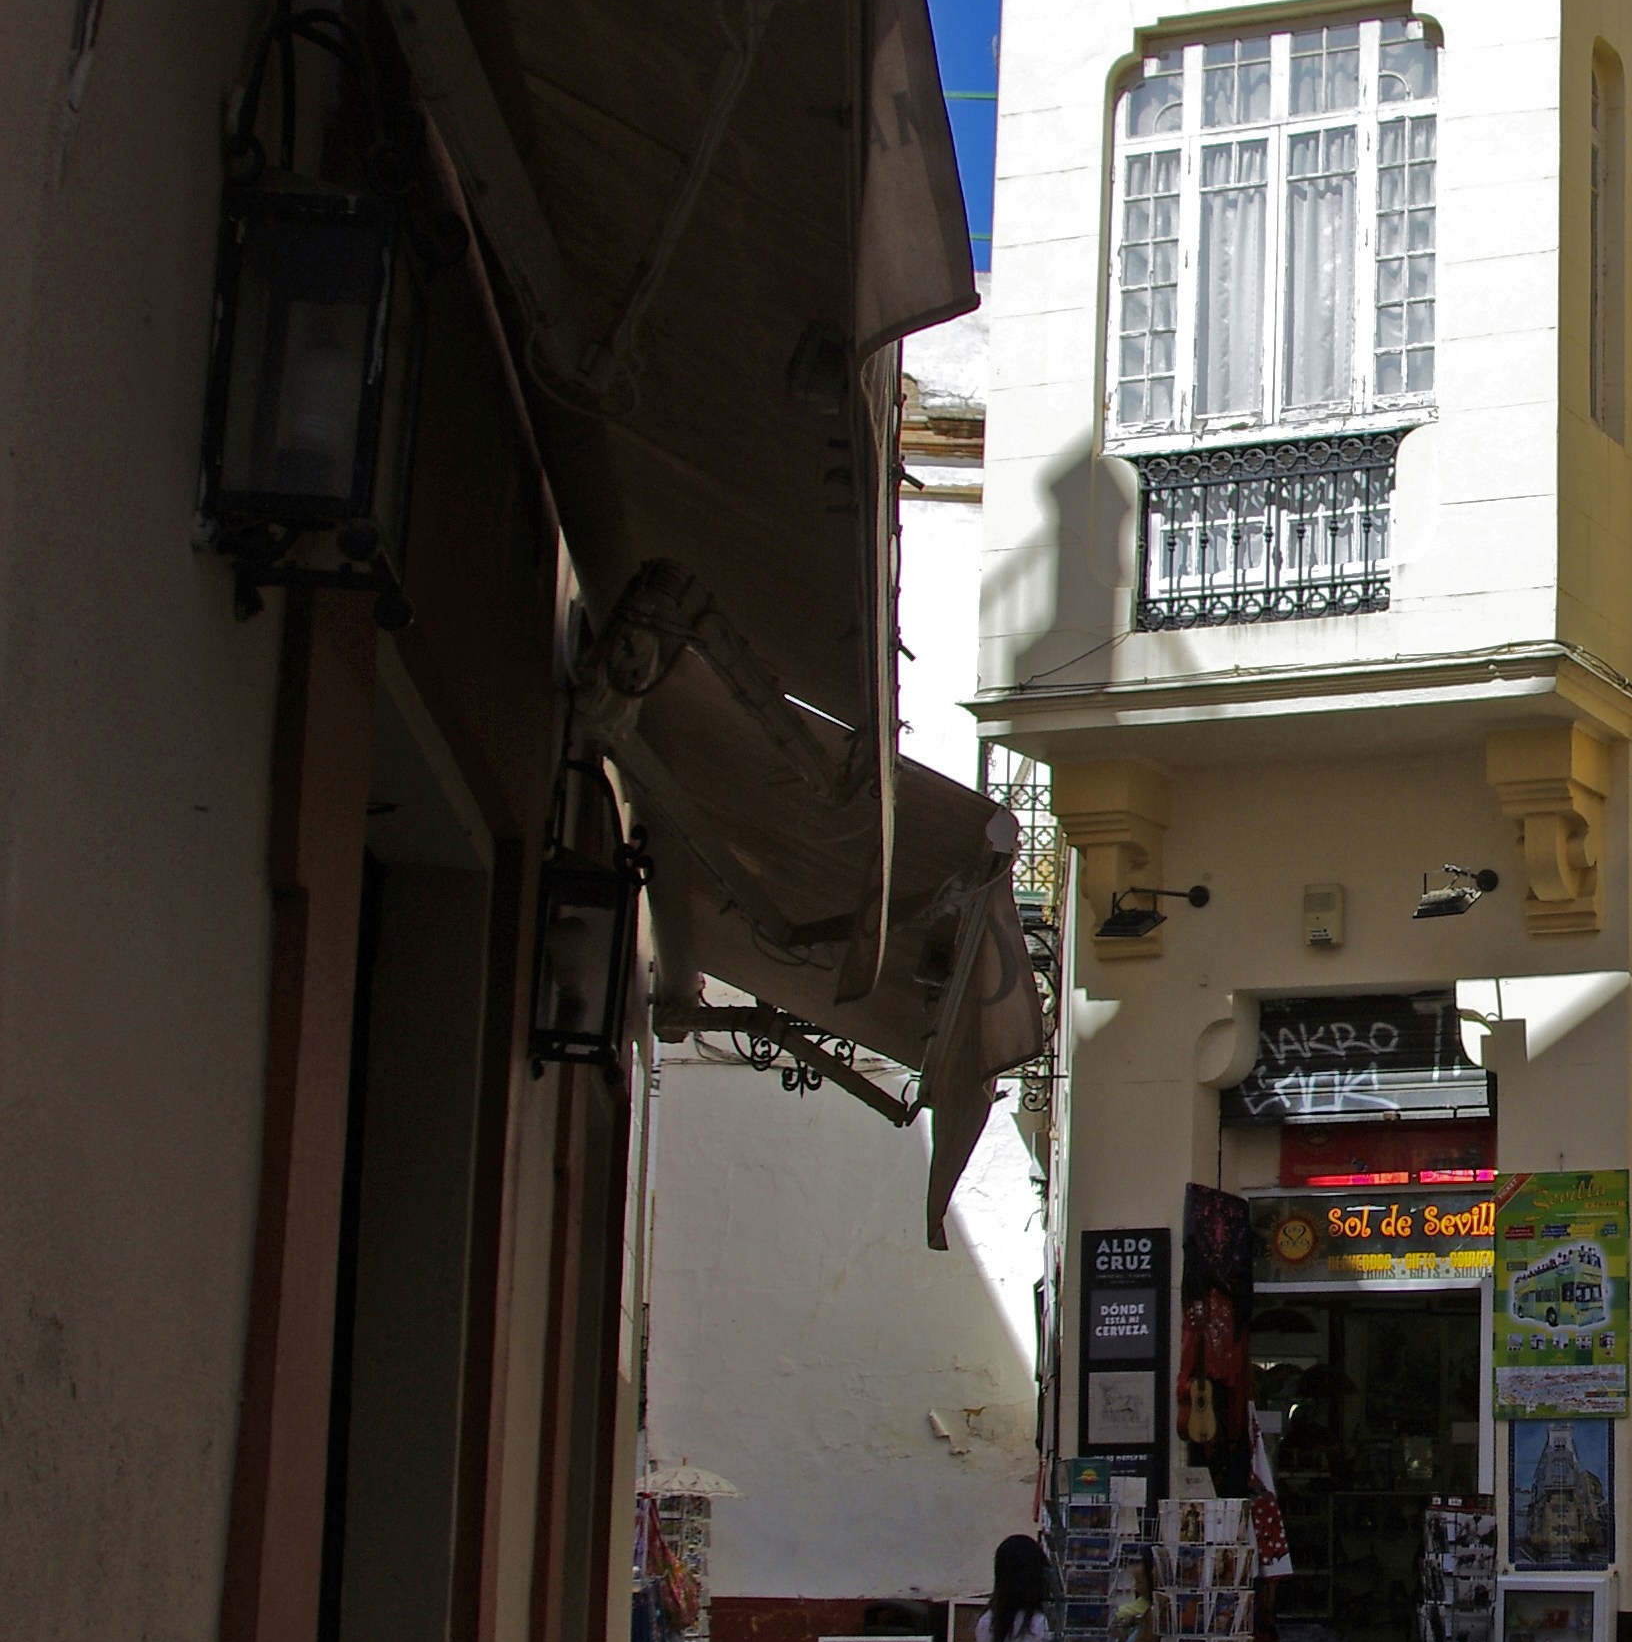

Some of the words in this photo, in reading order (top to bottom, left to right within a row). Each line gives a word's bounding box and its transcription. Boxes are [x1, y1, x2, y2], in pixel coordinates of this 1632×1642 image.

[1327, 1202, 1373, 1238] Sol
[1380, 1202, 1414, 1238] de
[1423, 1201, 1496, 1238] Sevill
[1097, 1238, 1153, 1255] ALDO
[1096, 1255, 1152, 1272] CRUZ
[1404, 1251, 1437, 1271] GIFTS
[1449, 1249, 1496, 1270] SOUVEN
[1100, 1302, 1145, 1316] DÓNDE
[1095, 1324, 1149, 1337] CERVEZA
